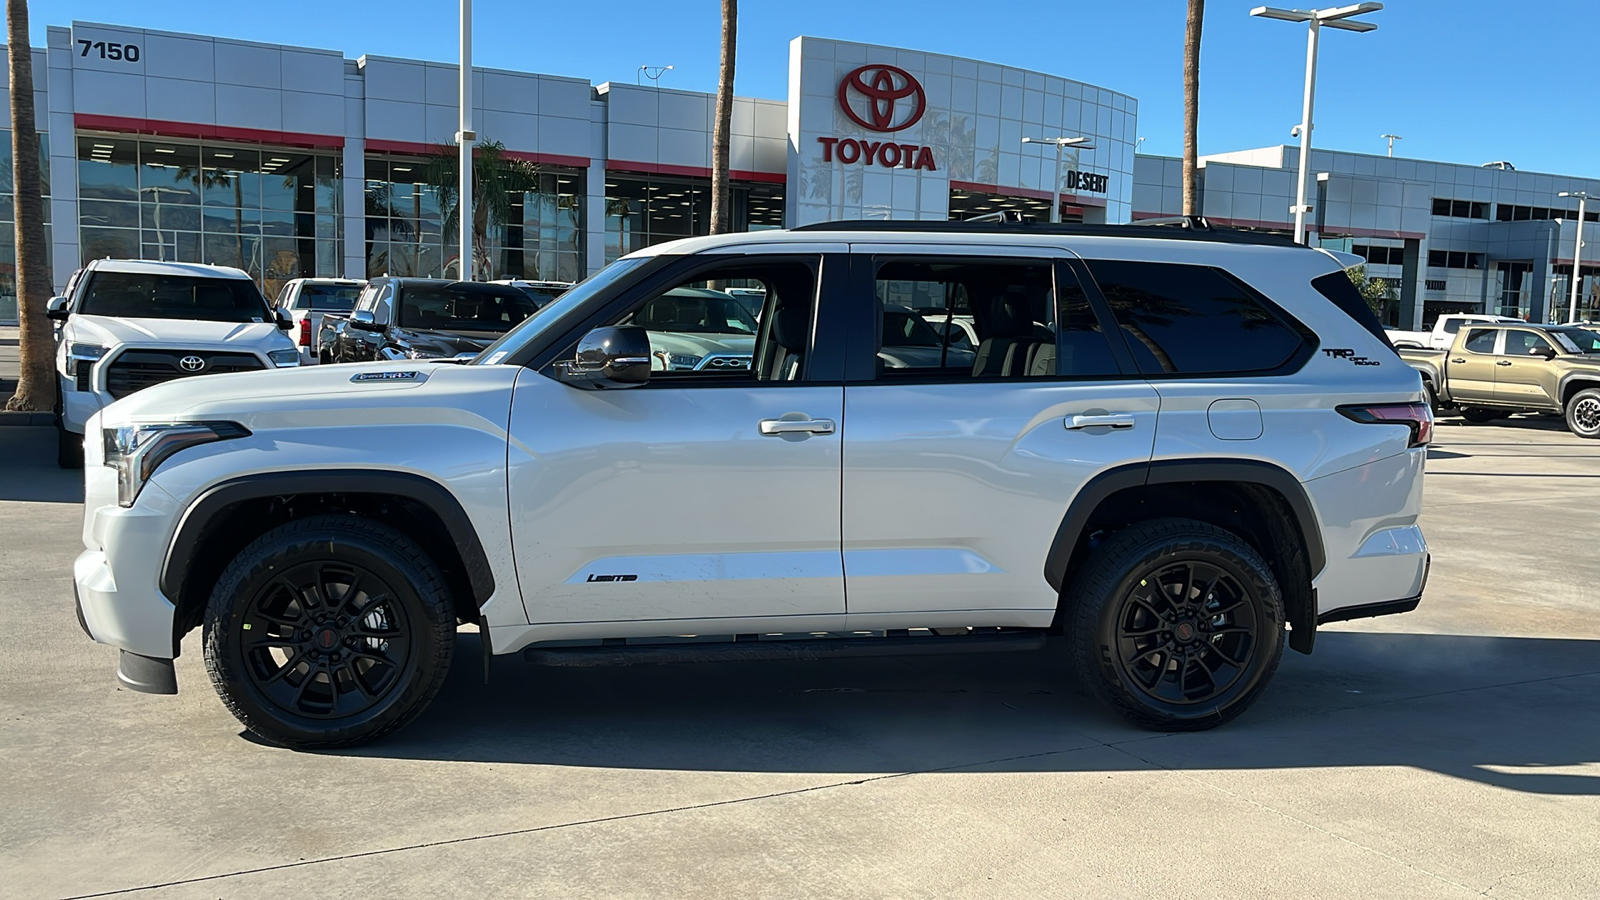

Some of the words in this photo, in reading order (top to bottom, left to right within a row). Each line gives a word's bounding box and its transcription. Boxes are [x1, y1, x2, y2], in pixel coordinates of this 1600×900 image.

[77, 39, 140, 62] 7150
[817, 137, 936, 171] TOYOTA
[1067, 170, 1109, 193] DESERT
[1322, 349, 1355, 358] TRD
